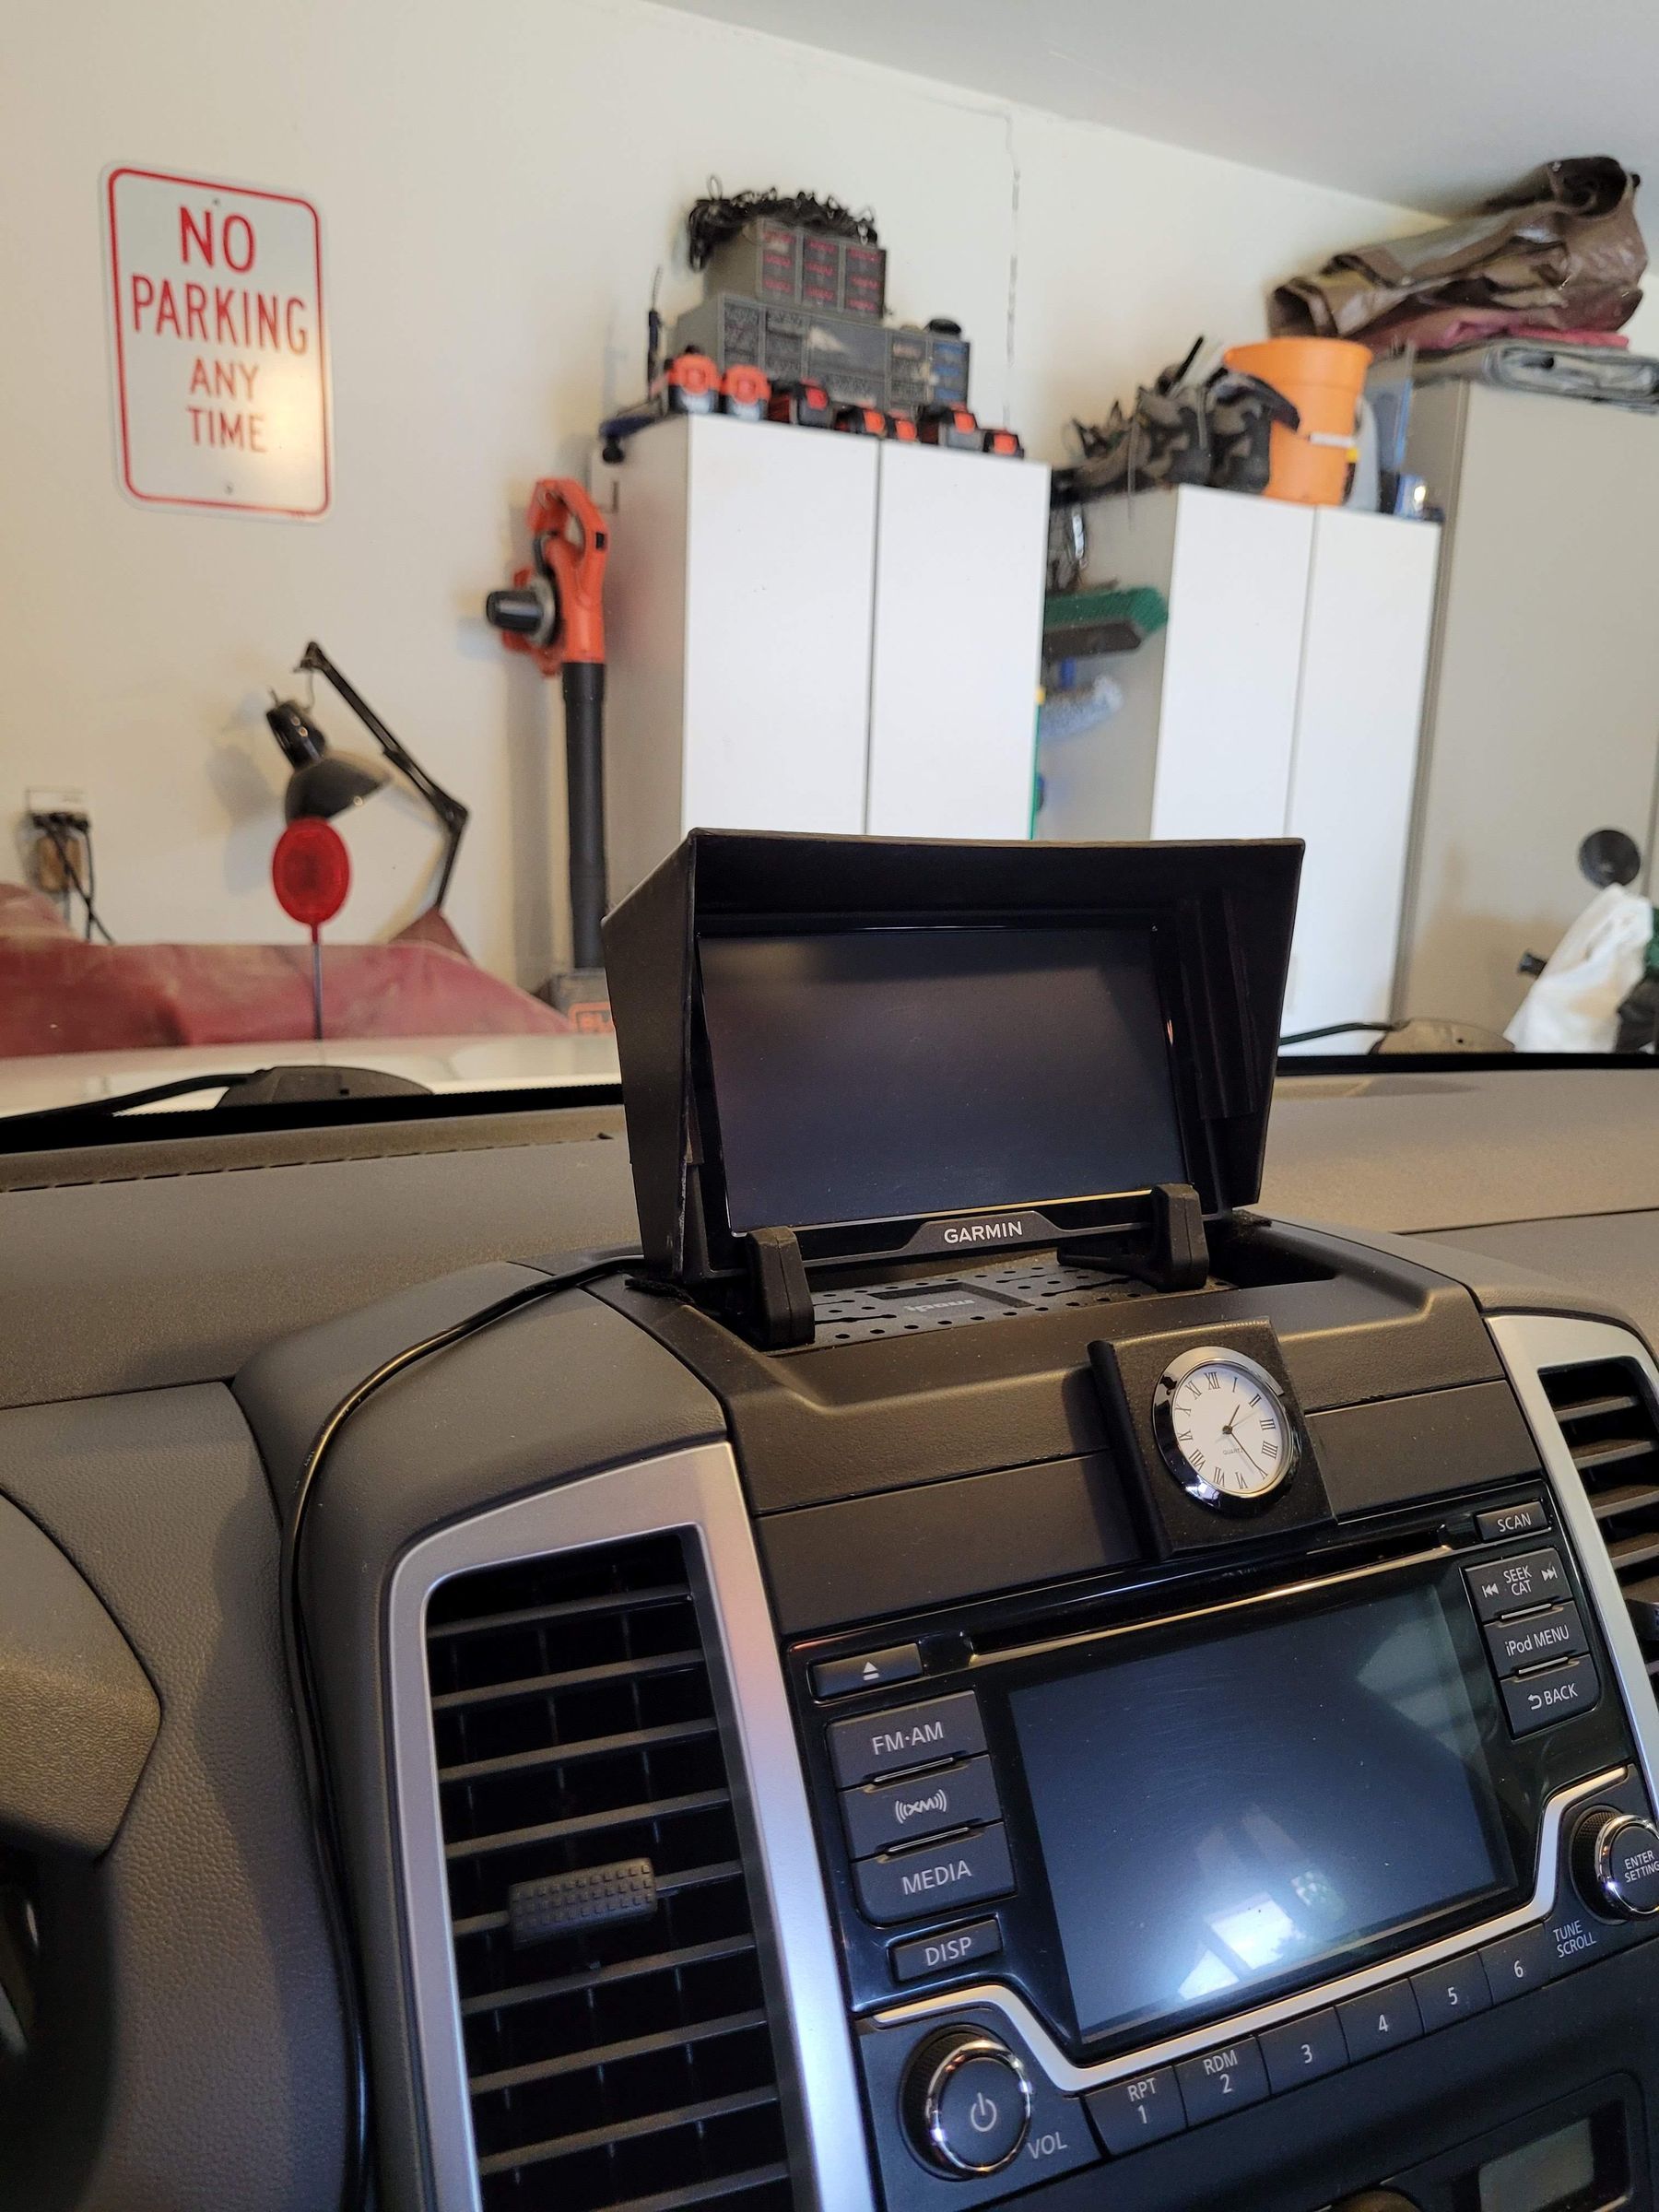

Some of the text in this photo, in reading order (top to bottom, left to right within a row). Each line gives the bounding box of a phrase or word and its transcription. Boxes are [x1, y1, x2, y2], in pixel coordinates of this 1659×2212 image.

[180, 206, 256, 274] NO
[131, 274, 309, 356] PARKING
[189, 357, 260, 402] ANY
[186, 406, 269, 453] TIME
[944, 1220, 1023, 1244] GARMIN
[1186, 1381, 1203, 1400] XI
[1205, 1371, 1221, 1390] XII
[1174, 1405, 1192, 1416] X
[1248, 1394, 1263, 1408] II
[1259, 1418, 1277, 1430] III
[1497, 1512, 1532, 1532] SCAN
[1503, 1565, 1532, 1583] SEEK
[1511, 1580, 1532, 1595] CAT
[1504, 1624, 1570, 1656] iPod MENU
[1543, 1682, 1578, 1705] BACK
[1624, 1850, 1655, 1870] ENTER
[901, 1860, 973, 1896] MEDIA
[1553, 1920, 1583, 1943] TUNE
[924, 1936, 972, 1967] DISP
[1556, 1932, 1597, 1959] SCROLL
[1513, 1959, 1524, 1979] 6
[1447, 1986, 1458, 2006] 5
[1378, 2014, 1389, 2032] 4
[1203, 2049, 1239, 2076] RDM
[1300, 2043, 1313, 2065] 3
[1127, 2077, 1157, 2102] RPT
[1219, 2074, 1233, 2094] 2
[1137, 2104, 1148, 2124] 1
[1027, 2131, 1068, 2159] VOL
